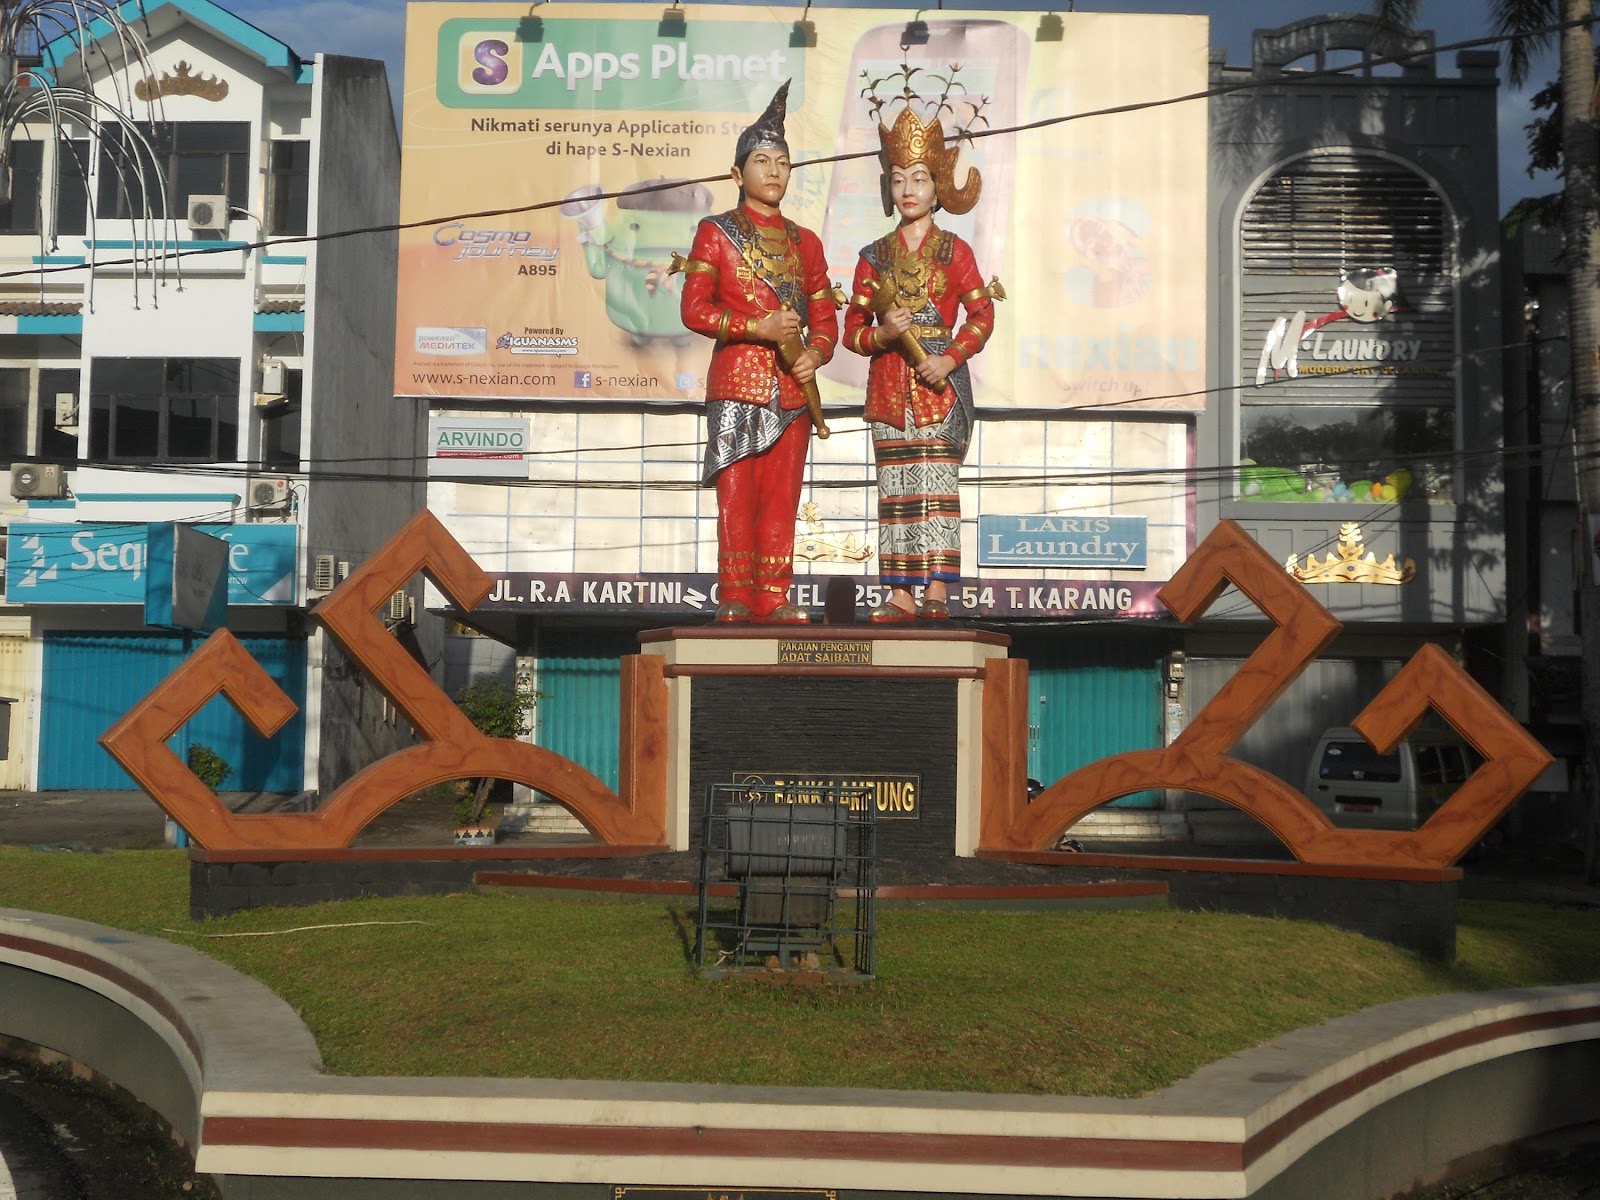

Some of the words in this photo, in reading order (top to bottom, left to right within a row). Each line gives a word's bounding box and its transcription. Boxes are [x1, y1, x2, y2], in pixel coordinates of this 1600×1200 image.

[532, 42, 640, 91] Apps
[651, 42, 786, 82] Planet
[471, 118, 540, 133] Nikmati
[544, 120, 613, 137] serunya
[617, 120, 716, 138] Application
[546, 141, 562, 156] di
[566, 142, 607, 160] hape
[612, 143, 691, 158] S-Nexian
[432, 223, 531, 247] Cosmo
[517, 264, 557, 276] A895
[524, 327, 554, 335] Powered
[555, 327, 564, 335] By
[419, 342, 475, 350] MEDIATEK
[509, 336, 578, 346] IGUANASMS
[1019, 320, 1197, 372] nexian
[1298, 364, 1349, 374] MODERN
[413, 371, 556, 386] www.s-nexian.com
[595, 374, 658, 387] s-nexian
[1063, 378, 1118, 392] switch
[437, 431, 523, 447] ARVINDO
[1017, 518, 1110, 534] LARIS
[987, 534, 1139, 562] Laundry
[488, 579, 524, 602] JL.
[530, 580, 571, 602] R.A
[582, 581, 681, 604] KARTINI
[780, 641, 818, 652] PAKAIAN
[820, 642, 870, 652] PENGANTIN
[780, 652, 810, 663] ADAT
[814, 653, 870, 663] SAIBATIN
